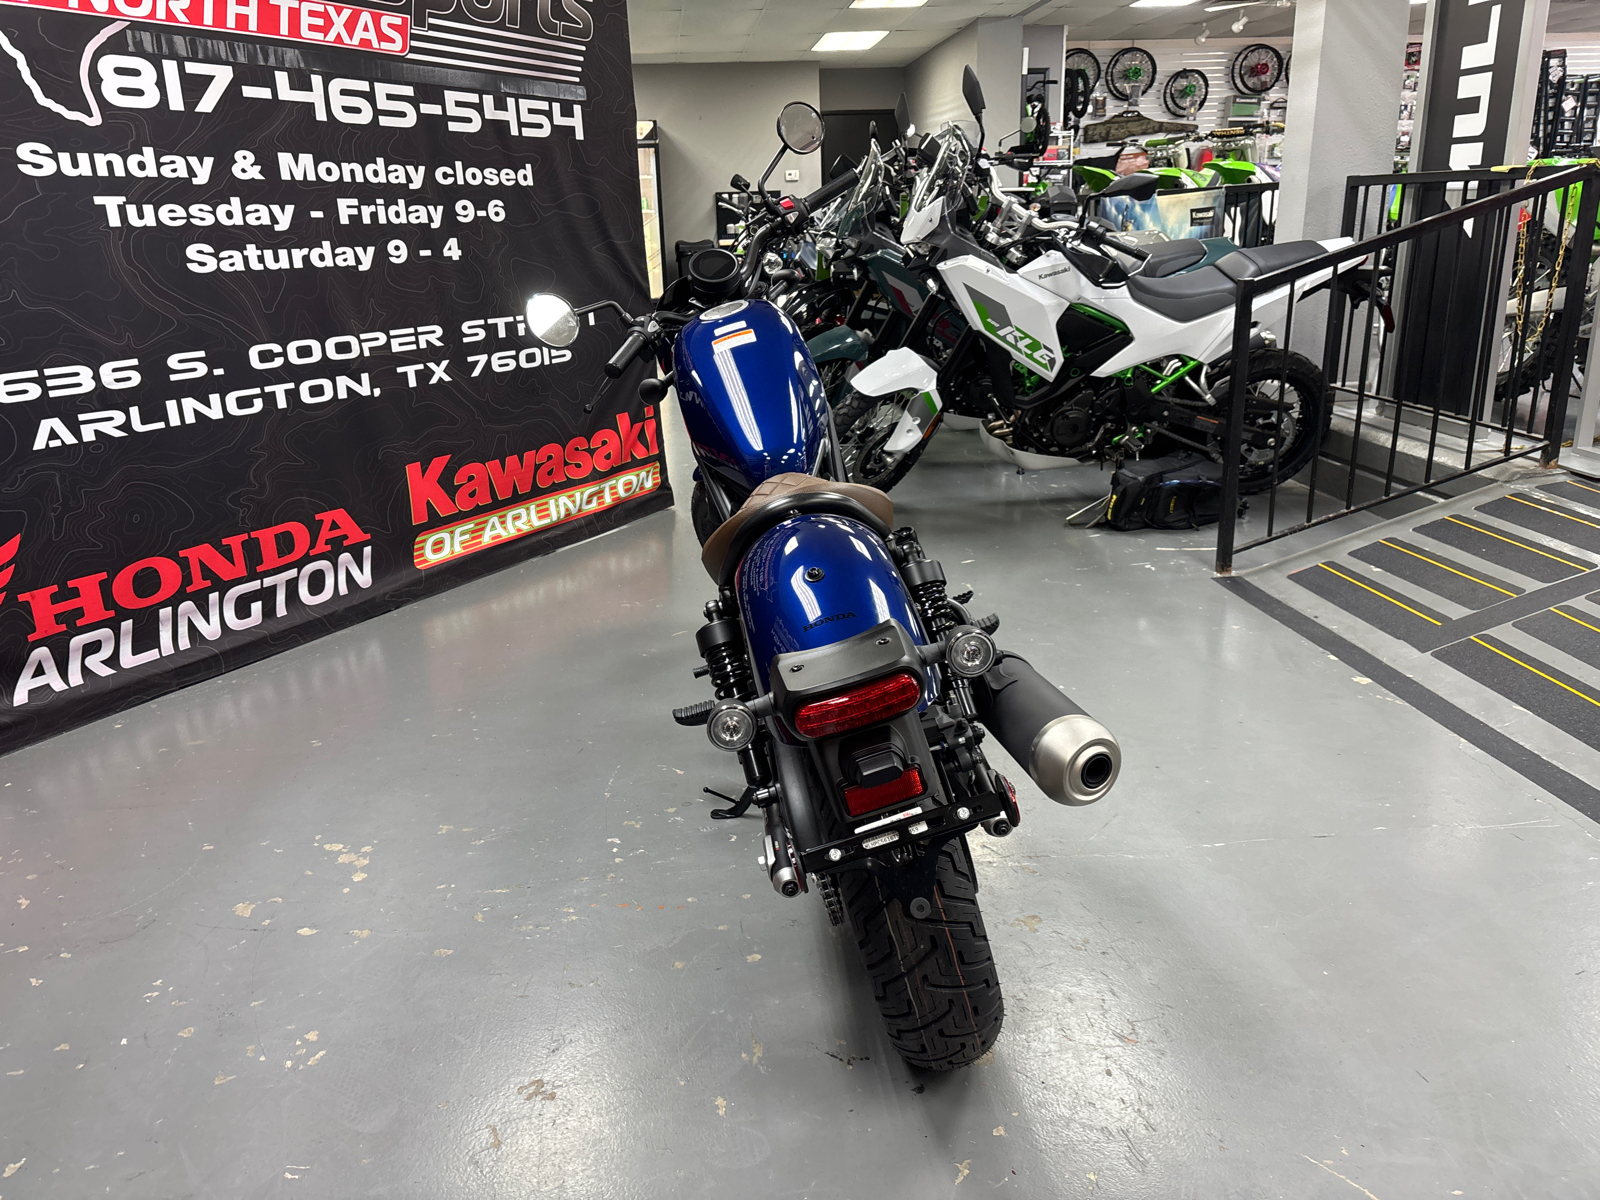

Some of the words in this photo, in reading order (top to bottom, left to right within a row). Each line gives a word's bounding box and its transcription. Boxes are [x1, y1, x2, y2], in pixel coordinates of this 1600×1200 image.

[68, 0, 258, 31] RTH
[269, 0, 402, 51] TEXAS
[97, 54, 585, 140] 817-465-5454
[16, 142, 214, 185] Sunday
[231, 149, 262, 180] &
[278, 152, 426, 188] Monday
[434, 160, 534, 188] closed
[94, 195, 297, 232] Tuesday
[338, 198, 444, 229] Friday
[455, 199, 506, 224] 9-6
[185, 241, 375, 274] Saturday
[387, 243, 408, 265] 9
[443, 241, 462, 261] 4
[1038, 266, 1071, 280] Kawasaki
[168, 350, 225, 382] S.
[248, 325, 443, 370] COOPER
[32, 371, 382, 451] ARLINGTON,
[398, 358, 452, 388] TX
[467, 346, 572, 378] 76015
[406, 405, 658, 525] Kawasaki
[423, 528, 473, 561] OF
[481, 470, 654, 544] ARLINGTON
[18, 508, 371, 643] HONDA
[13, 545, 373, 706] ARLINGTON
[802, 612, 857, 632] HONDA
